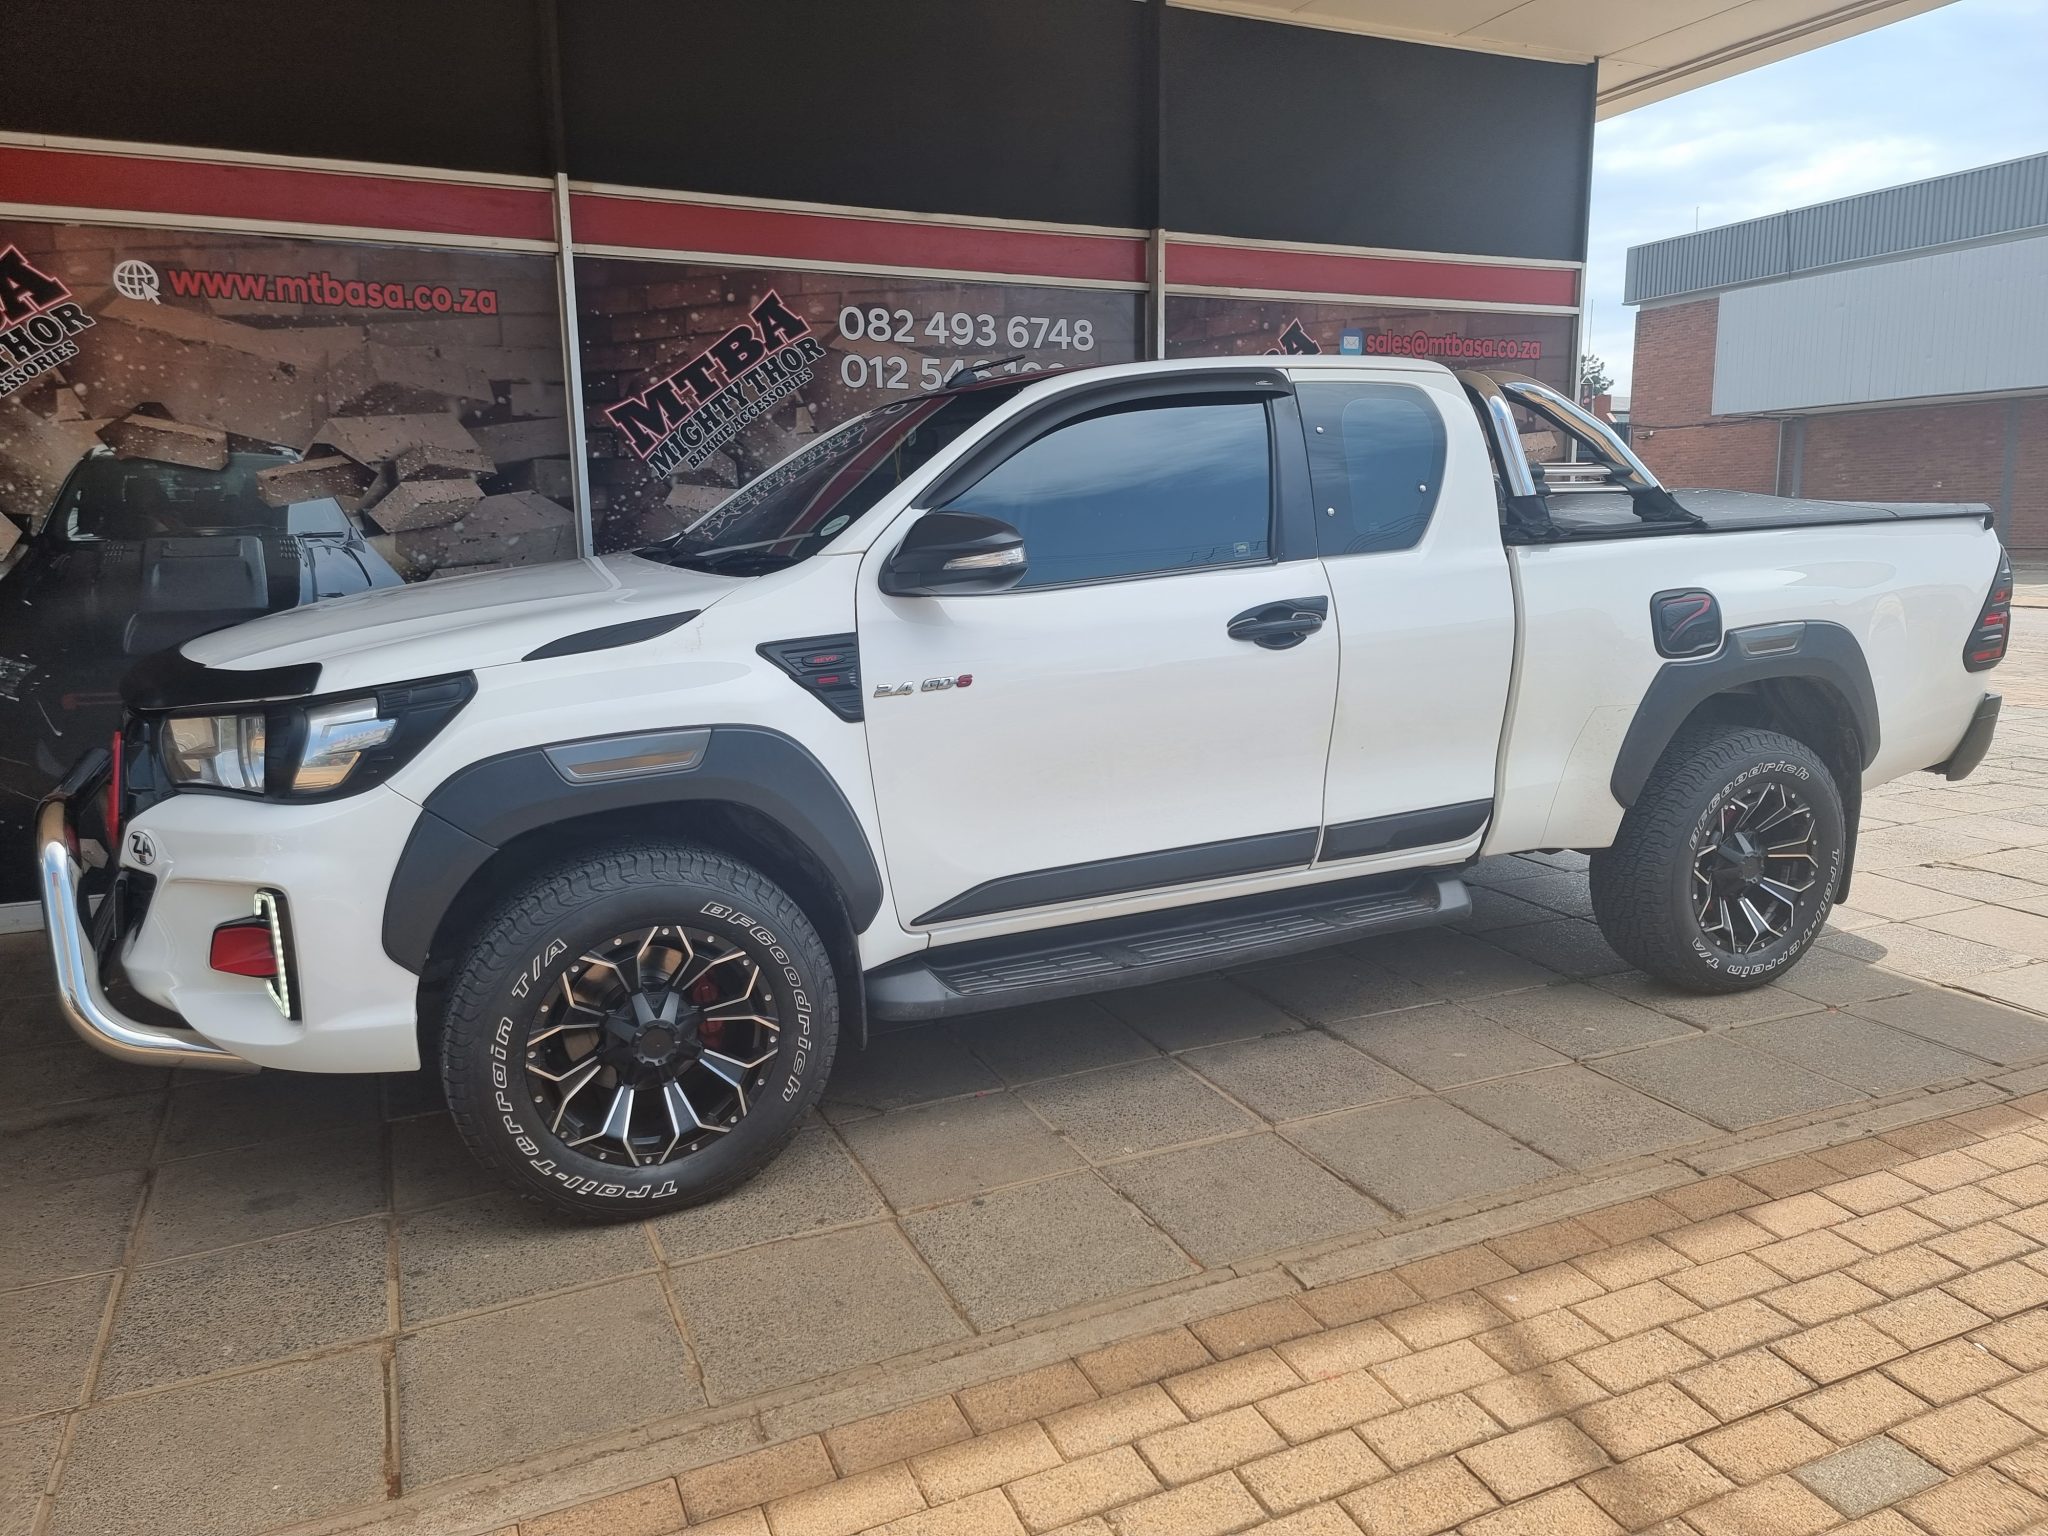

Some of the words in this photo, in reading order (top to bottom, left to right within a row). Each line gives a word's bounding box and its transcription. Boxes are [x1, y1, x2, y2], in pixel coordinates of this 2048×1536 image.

[168, 269, 498, 314] www.mtbasa.co.za
[838, 306, 915, 342] 082
[924, 311, 998, 347] 493
[1006, 315, 1095, 351] 6748
[1366, 329, 1541, 359] sales@mtbasa.co.za
[605, 288, 812, 459] MTBA
[840, 354, 909, 390] 012
[647, 380, 751, 479] MIGHTY
[742, 336, 827, 397] THOR
[687, 421, 735, 470] BAKKIE
[732, 367, 815, 432] ACCESSORIES
[921, 674, 973, 692] GD-6
[1689, 760, 1810, 850] BFGoodrich
[132, 834, 153, 857] ZA
[512, 938, 568, 998] T/A
[700, 901, 812, 1102] BFGoodrich
[491, 1016, 678, 1199] Trail-Terrain
